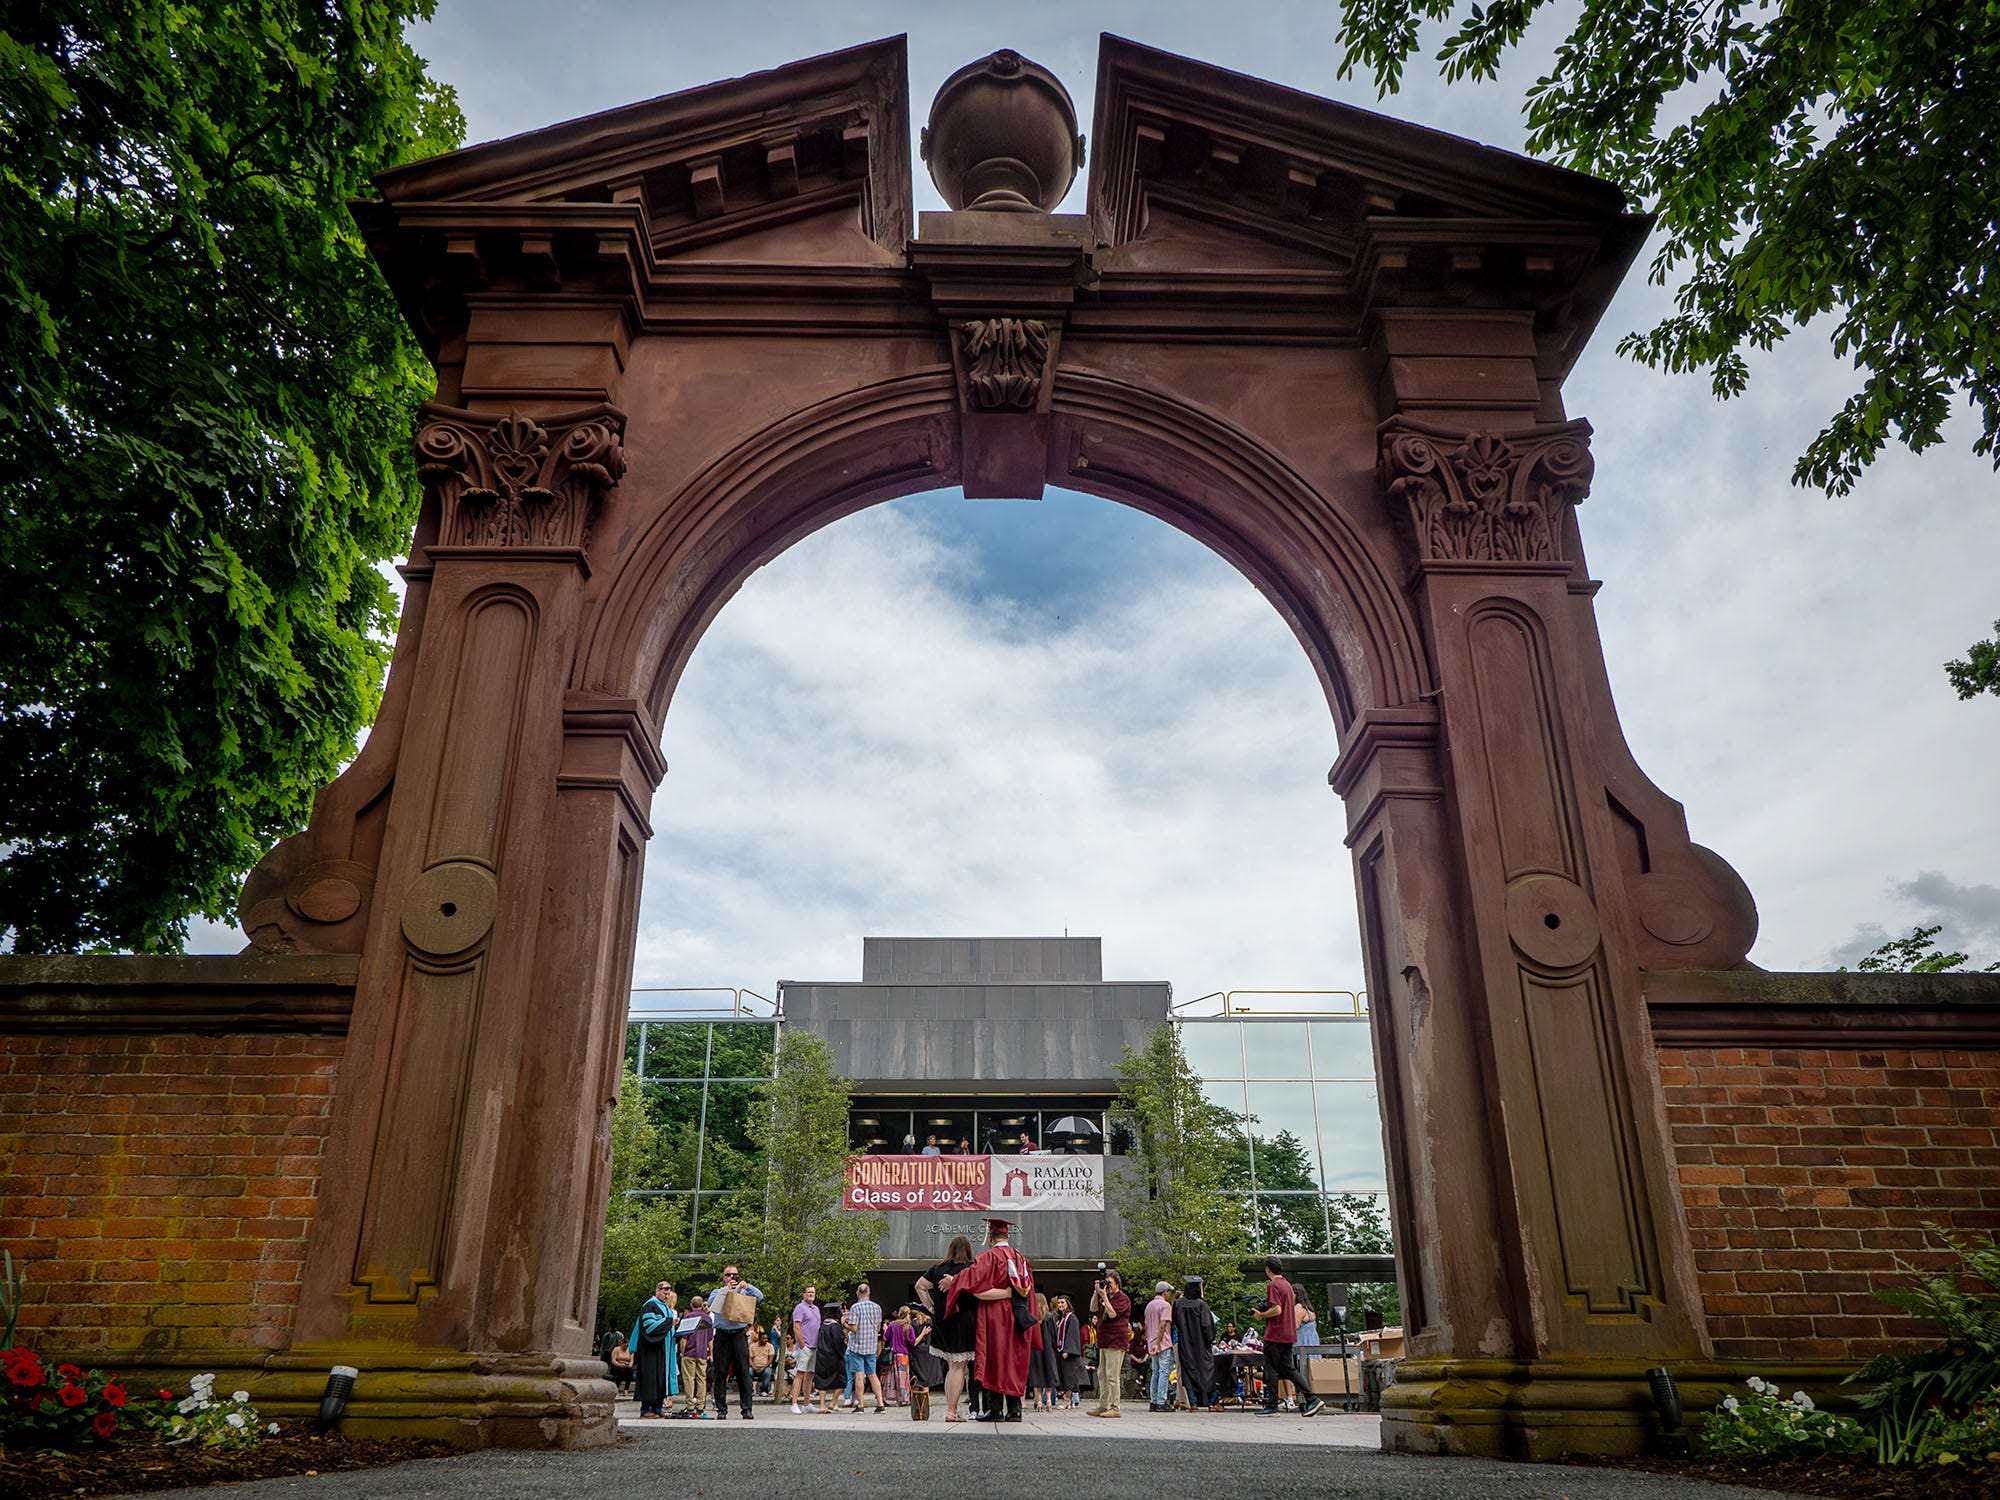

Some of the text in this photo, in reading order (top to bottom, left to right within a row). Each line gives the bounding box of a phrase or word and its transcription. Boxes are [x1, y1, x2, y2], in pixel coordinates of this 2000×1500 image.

[852, 1162, 985, 1185] CONGRATULATIONS
[1034, 1167, 1093, 1178] RAMAPO
[1034, 1180, 1093, 1190] COLLEGE
[851, 1188, 974, 1203] Class of 2024
[924, 1224, 975, 1233] ACADEMIC
